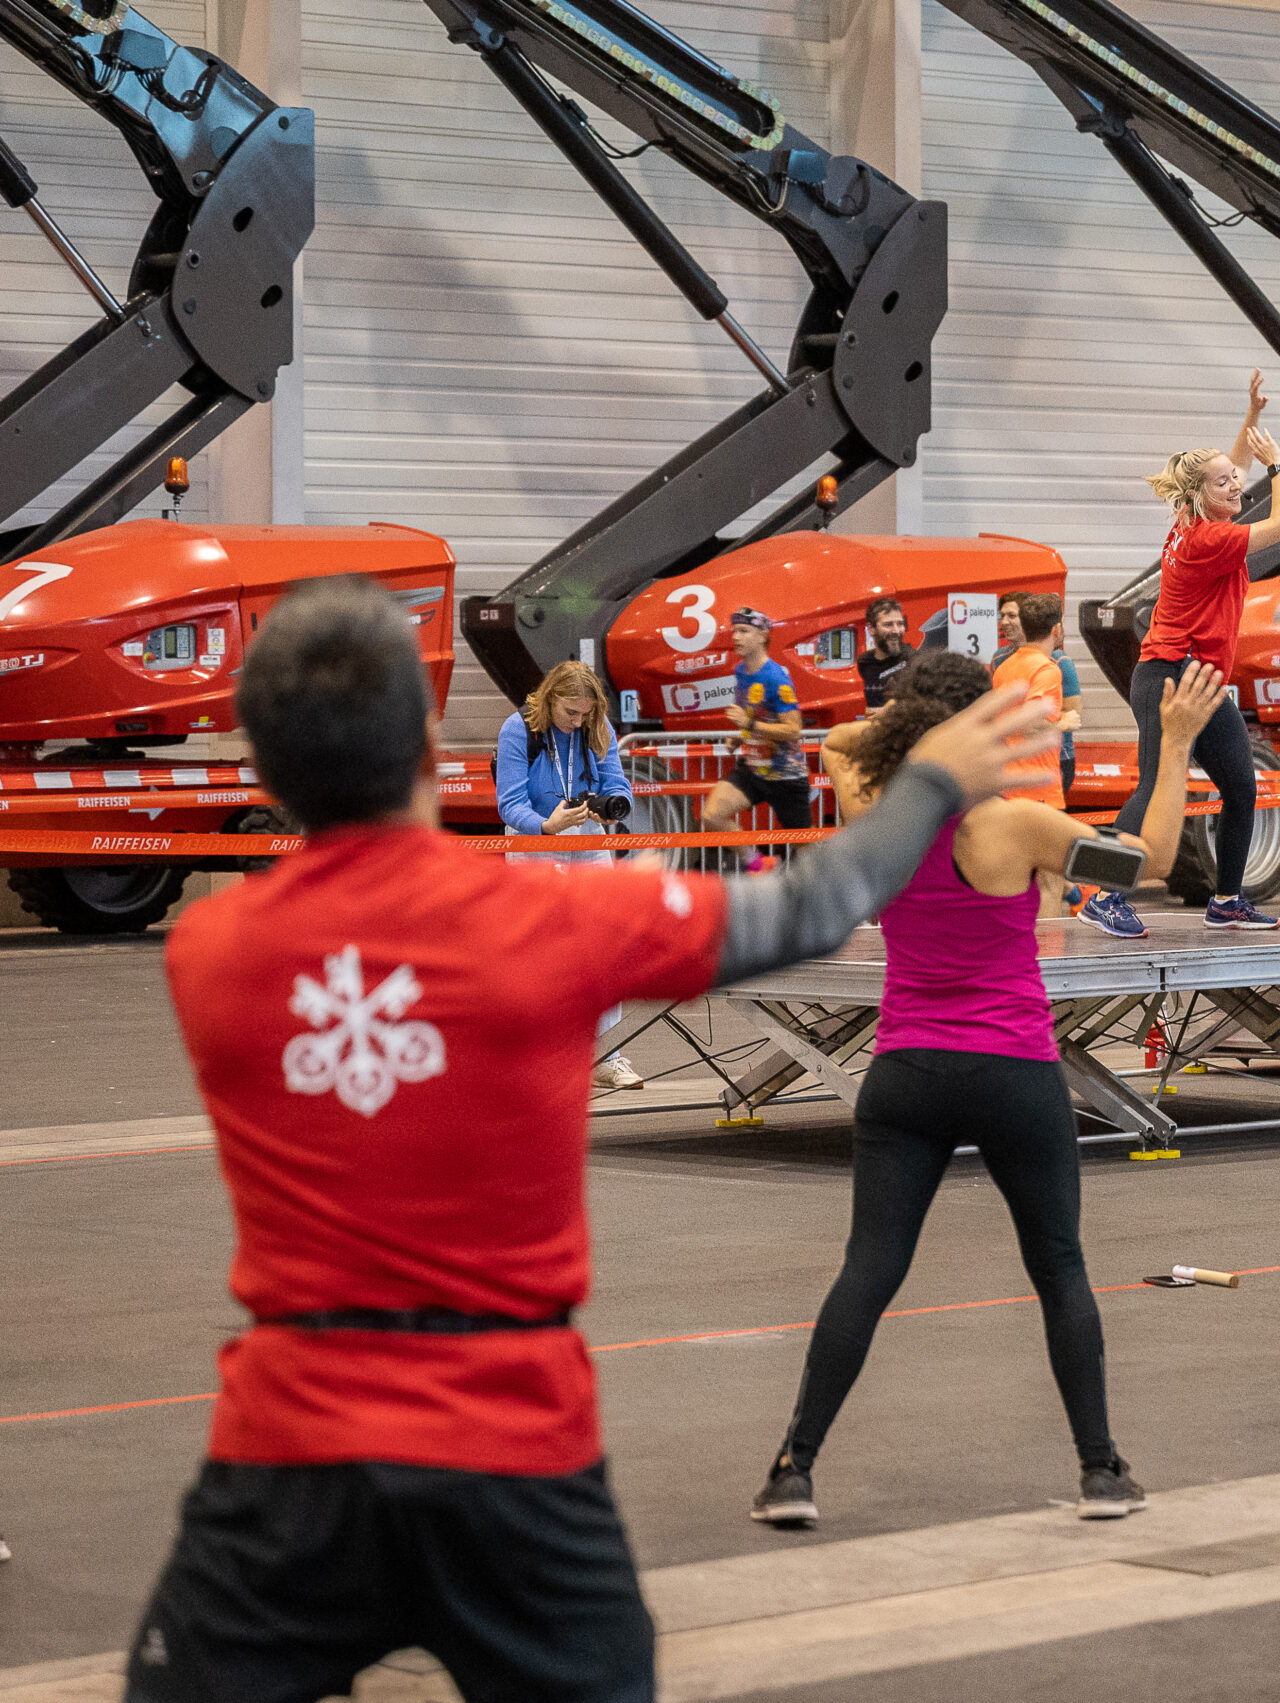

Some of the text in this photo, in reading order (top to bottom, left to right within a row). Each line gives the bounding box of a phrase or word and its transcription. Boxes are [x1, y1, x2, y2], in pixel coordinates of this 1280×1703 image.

[0, 561, 74, 621] 7
[661, 584, 717, 653] 3
[969, 607, 995, 618] palexpo
[967, 633, 980, 656] 3
[21, 653, 45, 666] TJ
[706, 651, 729, 666] TJ
[77, 791, 249, 808] RAIFFEISEN RAIFFEISEN
[91, 836, 172, 851] RAIFFEISEN
[601, 836, 673, 848] RAIFFEISEN
[755, 831, 824, 842] RAIFFEISEN
